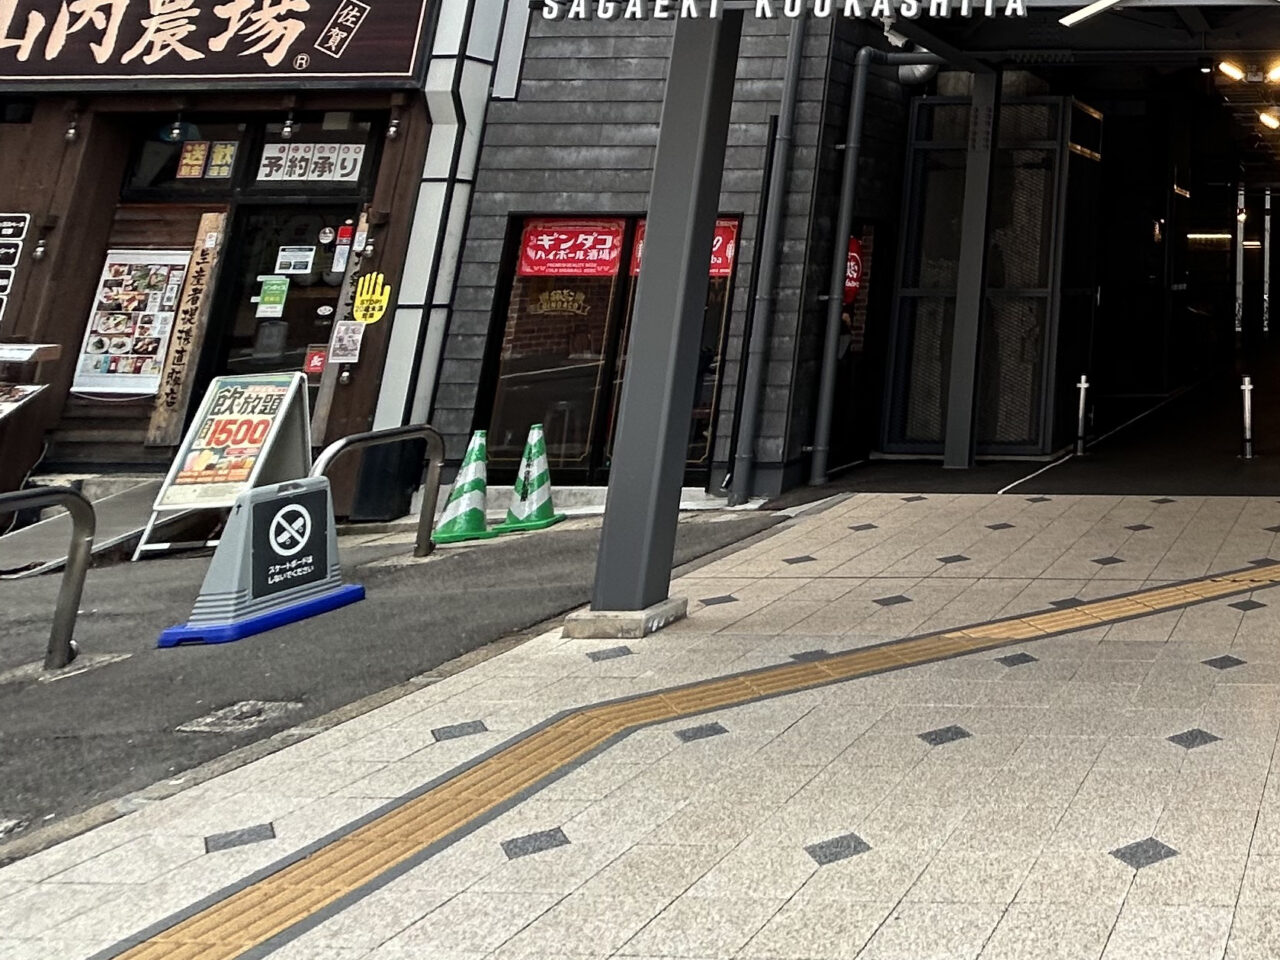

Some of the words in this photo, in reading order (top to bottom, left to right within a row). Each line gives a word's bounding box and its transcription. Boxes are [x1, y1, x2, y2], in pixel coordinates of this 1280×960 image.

[325, 3, 361, 52] 佐賀
[262, 156, 358, 178] 予約承り
[536, 232, 613, 250] ギンダコ
[205, 419, 272, 447] 1500
